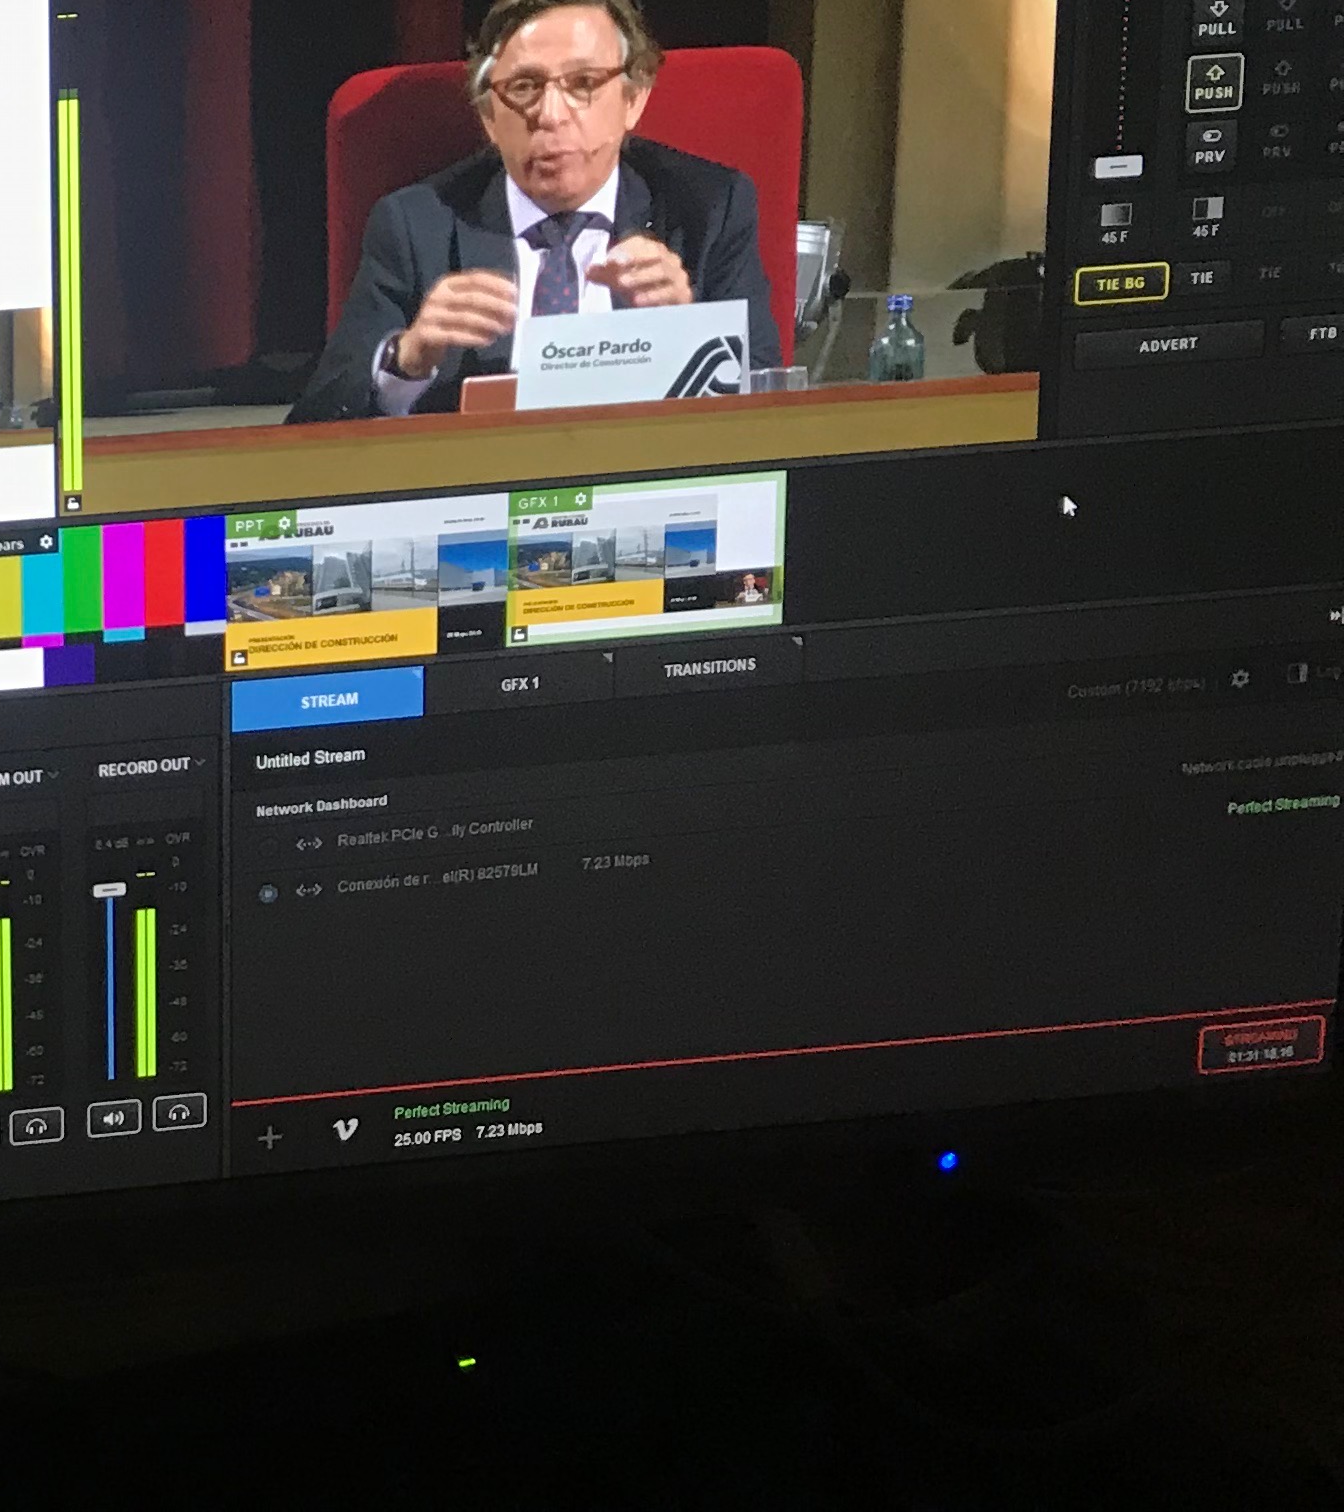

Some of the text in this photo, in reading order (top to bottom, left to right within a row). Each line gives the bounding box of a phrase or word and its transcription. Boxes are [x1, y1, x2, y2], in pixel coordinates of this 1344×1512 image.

[1198, 20, 1237, 38] PULL
[1265, 17, 1305, 32] PULL
[1194, 84, 1234, 101] PUSH
[1194, 148, 1226, 165] PRV
[1261, 144, 1292, 159] PRV
[1120, 229, 1130, 244] F
[1211, 223, 1221, 238] F
[1190, 270, 1215, 285] TIE
[1261, 265, 1283, 281] TIE
[1097, 275, 1147, 292] TIE BG
[1309, 325, 1339, 342] FTB
[541, 338, 652, 359] Óscar Pardo
[1138, 336, 1199, 354] ADVERT
[518, 495, 560, 511] GFX 1
[235, 518, 265, 533] PPT
[551, 516, 589, 529] RUBAU
[305, 640, 319, 651] DE
[320, 632, 399, 650] CONSTRUCCIÓN
[664, 656, 758, 679] TRANSITIONS
[501, 675, 541, 693] GFX 1
[300, 691, 359, 710] STREAM
[98, 756, 191, 779] RECORD OUT
[256, 747, 367, 771] Untitled Stream
[12, 768, 44, 787] OUT
[256, 794, 388, 818] Network Dashboard
[1227, 794, 1342, 815] Perfect Streaming
[337, 830, 389, 848] Realtek
[469, 817, 534, 836] Controller
[337, 874, 400, 893] Conexión
[404, 873, 420, 886] de
[394, 1097, 511, 1120] Perfect Streaming
[394, 1127, 463, 1147] 25.00 FPS
[476, 1122, 544, 1139] 7.23 Mbps
